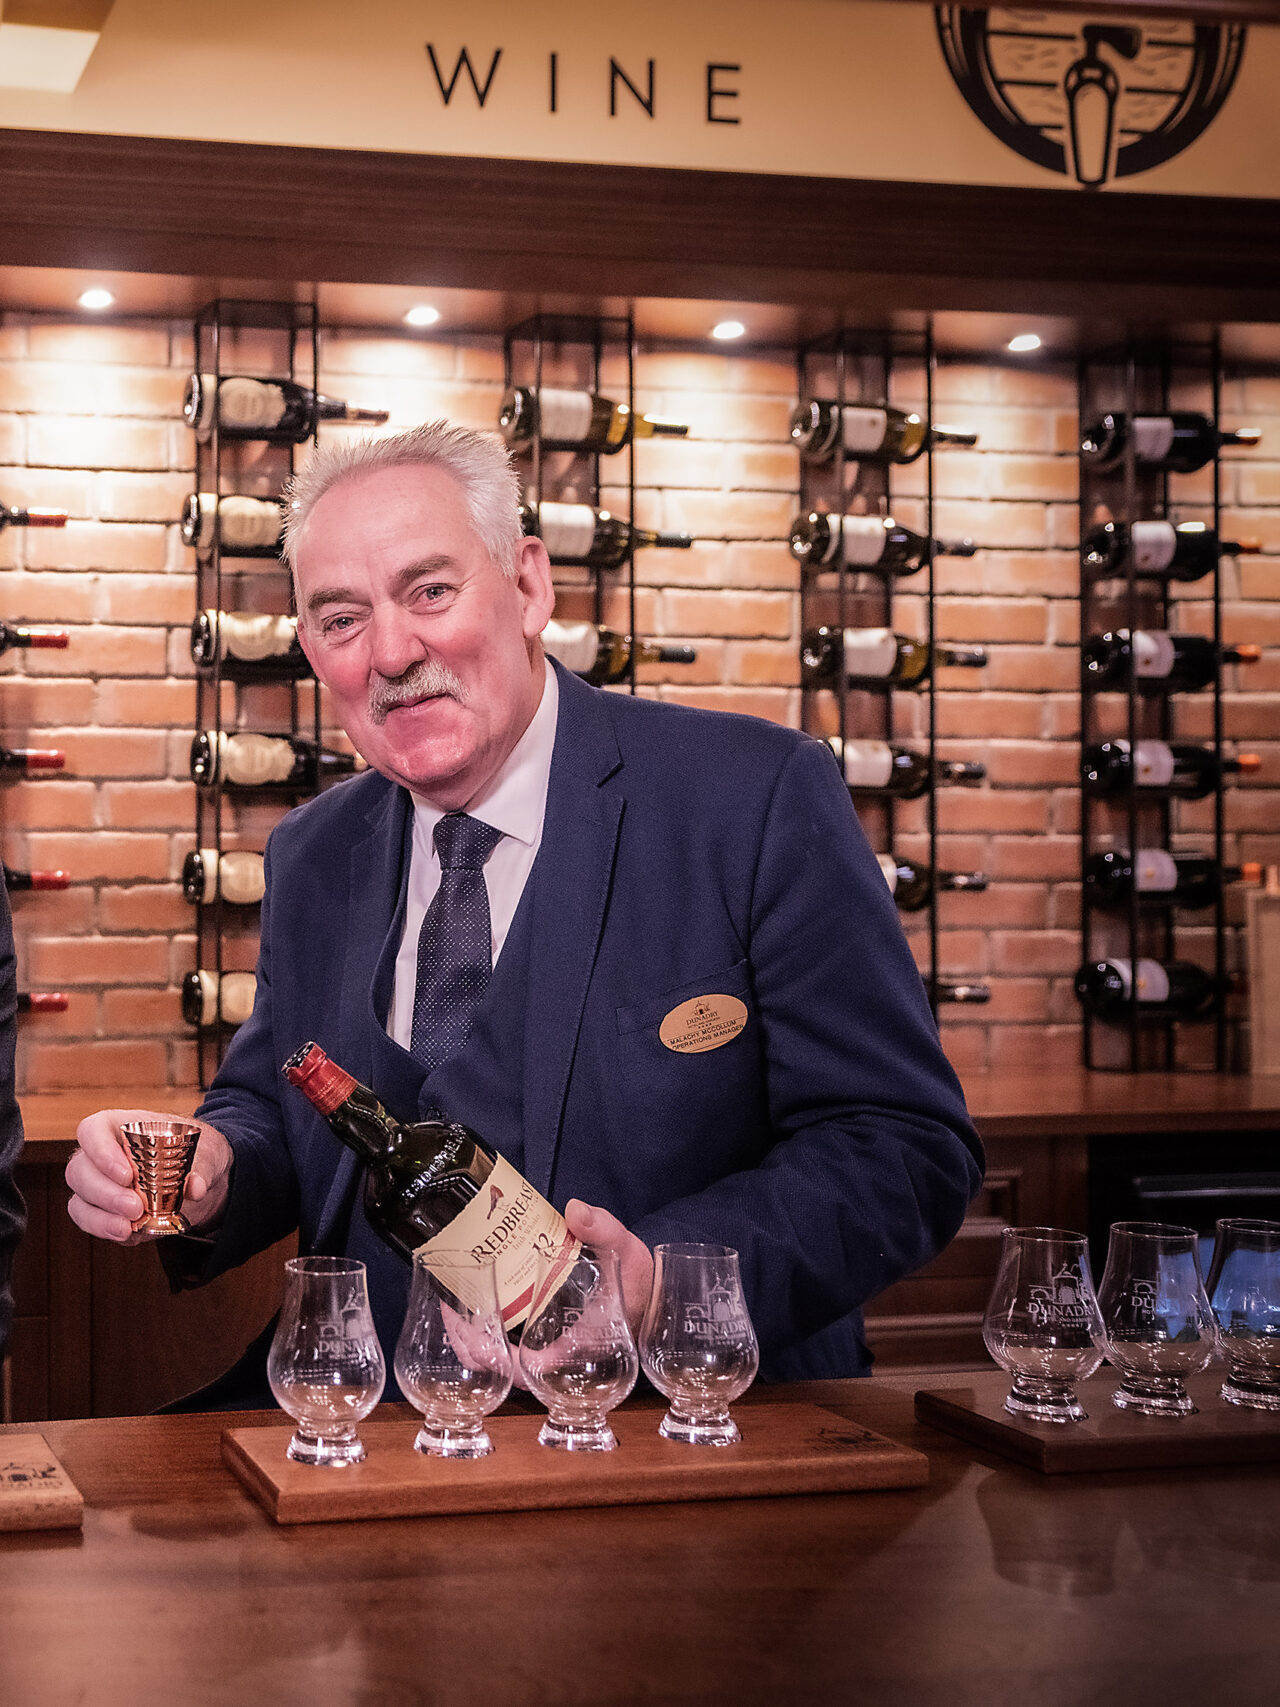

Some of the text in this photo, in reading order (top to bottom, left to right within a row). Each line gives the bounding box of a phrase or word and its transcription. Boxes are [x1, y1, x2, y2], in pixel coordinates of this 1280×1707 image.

[425, 42, 742, 125] WINE
[686, 1011, 719, 1026] DUNADRY
[670, 1020, 737, 1045] MALACHY MCCOLLUM
[672, 1024, 744, 1050] OPERATIONS MANAGER
[470, 1180, 535, 1264] REDBREAST
[532, 1232, 555, 1256] 12
